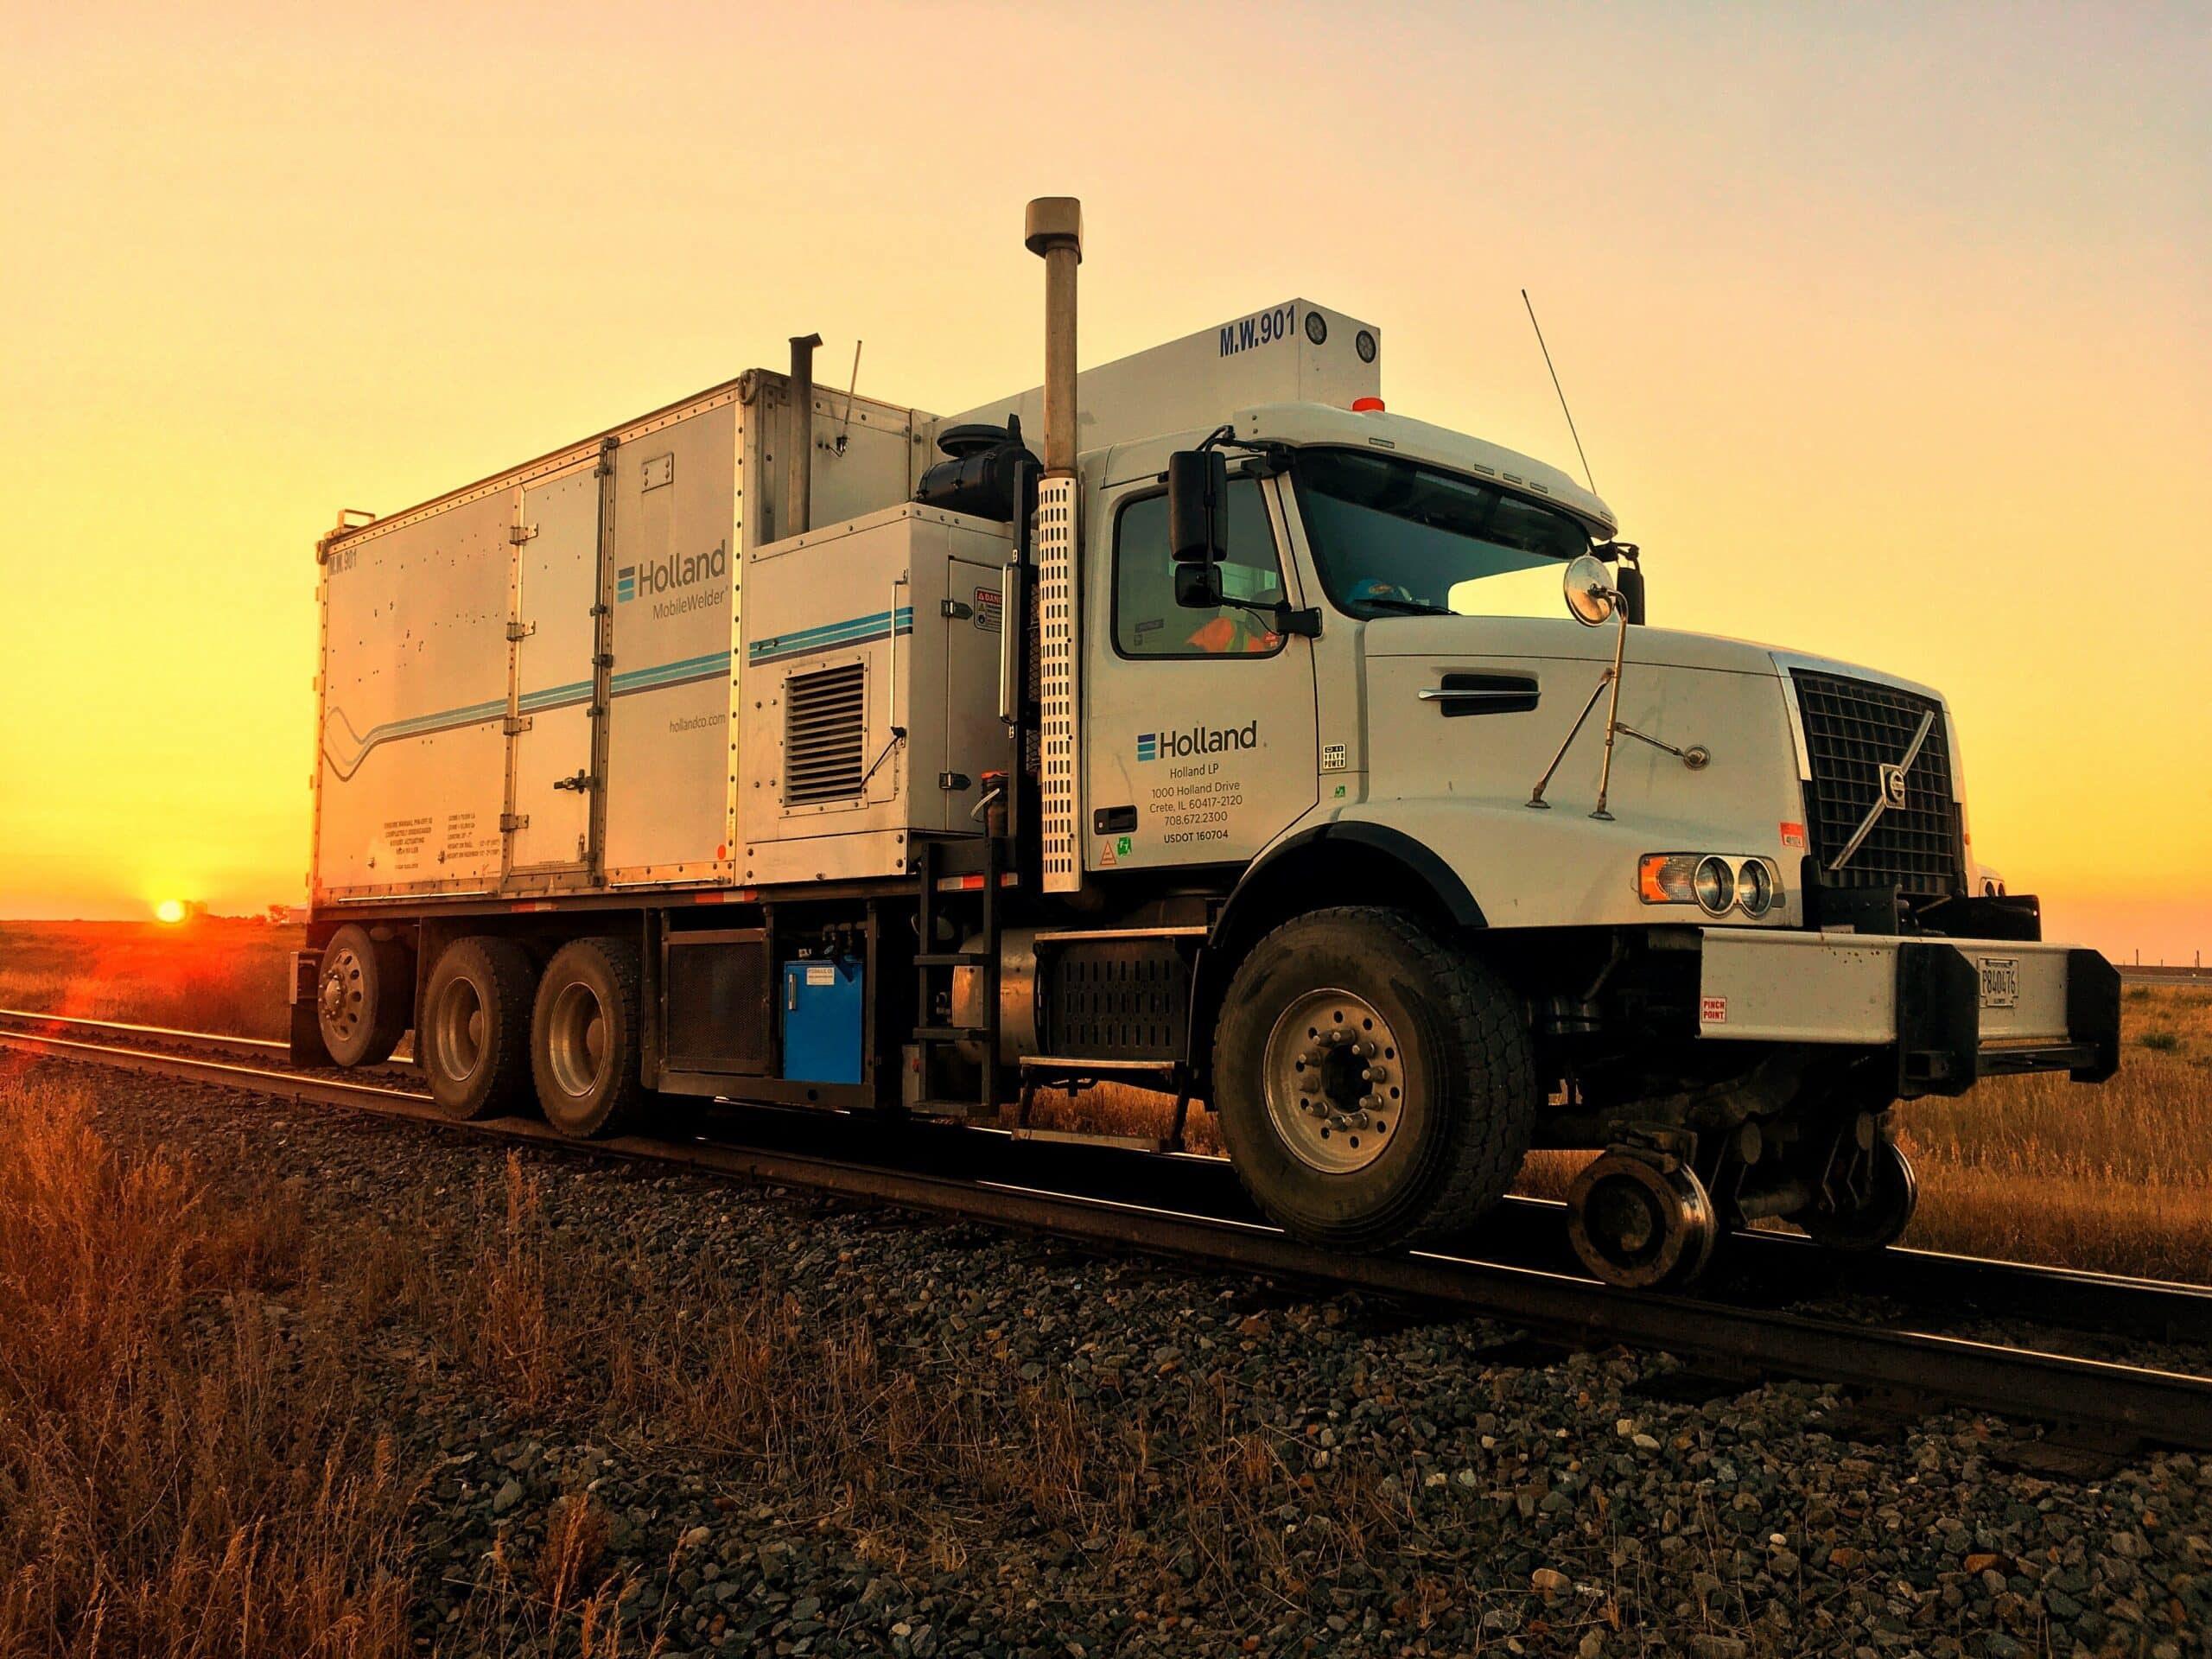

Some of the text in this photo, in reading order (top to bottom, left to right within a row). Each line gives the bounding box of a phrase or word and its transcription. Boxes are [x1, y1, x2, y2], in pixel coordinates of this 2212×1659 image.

[1219, 304, 1294, 358] M.W.901
[639, 538, 726, 597] Holland
[669, 713, 726, 734] hollandco.com
[1160, 719, 1257, 759] Holland
[1169, 763, 1219, 779] Holland LP
[1324, 760, 1344, 768] POWER
[1152, 780, 1241, 799] 1000 Holland Drive
[1149, 794, 1243, 813] Crete, IL 60417-2120
[1164, 810, 1229, 827] 708.672.2300
[1163, 830, 1229, 844] USDOT 160704
[1703, 1001, 1725, 1009] PINCH
[1703, 1011, 1724, 1020] POINT
